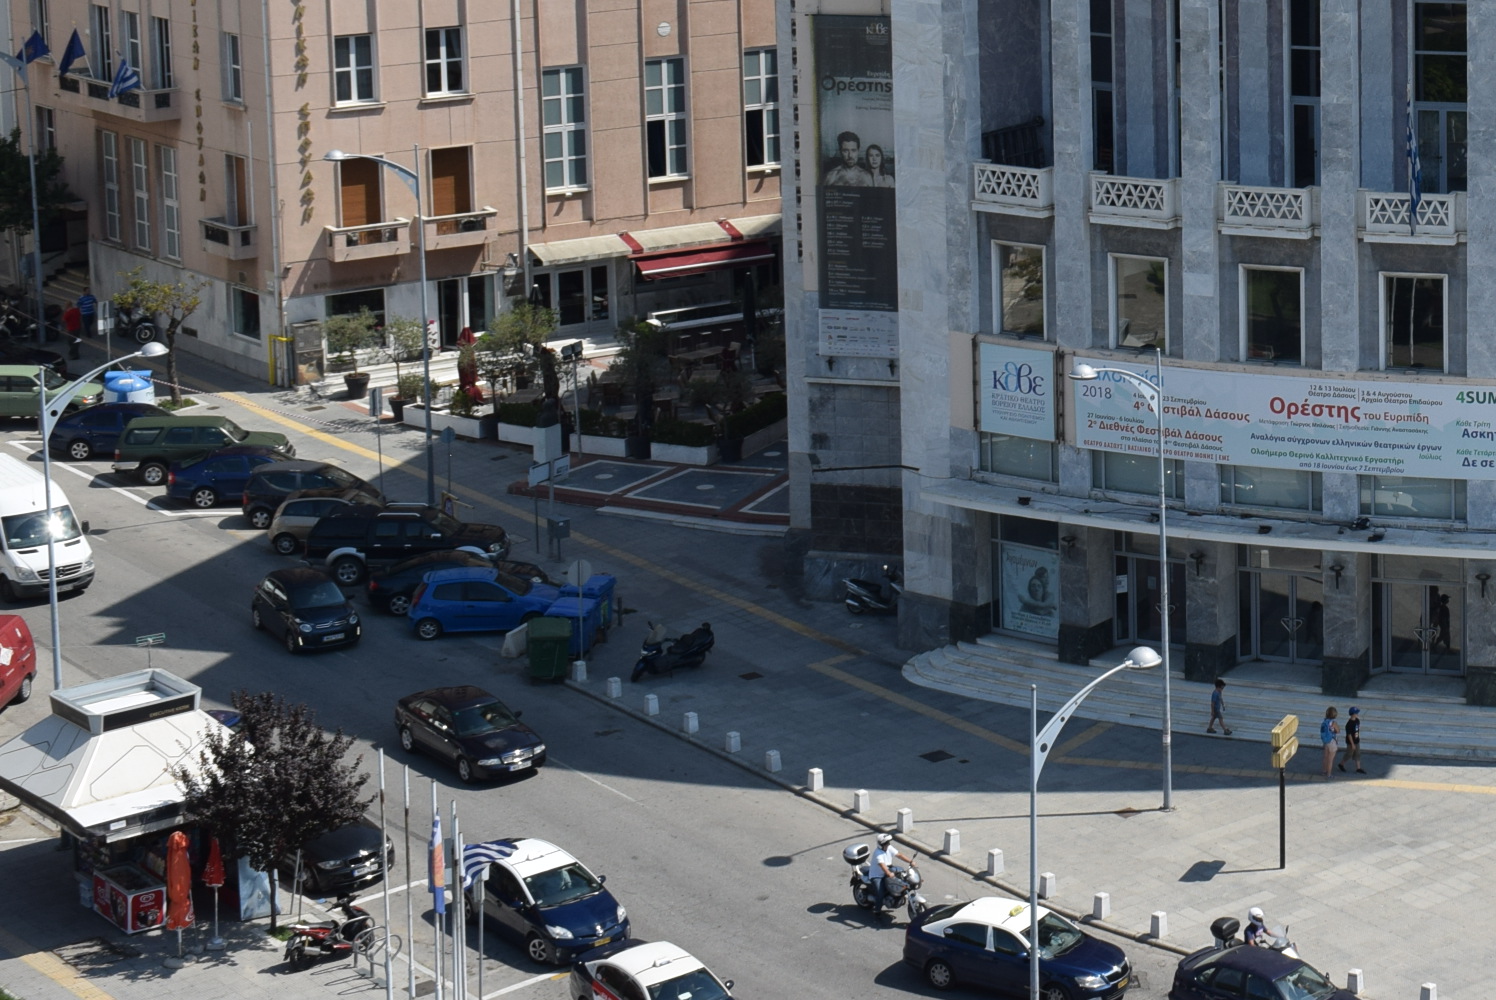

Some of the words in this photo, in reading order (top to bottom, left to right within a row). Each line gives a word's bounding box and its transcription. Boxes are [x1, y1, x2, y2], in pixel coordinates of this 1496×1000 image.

[821, 75, 892, 95] Ορέστης
[1082, 385, 1112, 399] 2018
[1308, 390, 1331, 399] Θέατρο
[1332, 391, 1357, 400] Δάσους
[1377, 391, 1412, 400] Αυγούστου
[992, 393, 1018, 401] ΚΡΑΤΙΚΟ
[1021, 397, 1045, 406] ΘΕΑΤΡΟ
[1171, 396, 1207, 405] Σεπτεμβρίου
[1361, 397, 1383, 405] Αρχαίο
[1384, 397, 1407, 406] Θέατρο
[1409, 398, 1443, 406] Επιδαύρου
[992, 400, 1017, 409] ΒΟΡΕΙΟΥ
[1018, 403, 1045, 413] ΕΛΛΑΔΟΣ
[1148, 404, 1202, 417] στιβάλ
[1205, 408, 1250, 422] Δάσους
[1269, 396, 1361, 423] Ορέστης
[1363, 412, 1381, 421] του
[1384, 412, 1429, 424] Ευριπίδη
[1095, 413, 1116, 421] Ιουνίου
[1290, 421, 1311, 429] Γιώργος
[1473, 421, 1491, 429] Τρίτη
[1099, 421, 1134, 434] Διεθνές
[1185, 429, 1223, 443] Δάσους
[1104, 442, 1123, 450] ΔΑΣΟΥΣ
[1128, 445, 1151, 453] ΒΑΣΙΛΙΚΟ
[1132, 436, 1152, 444] πλαίσιο
[1173, 441, 1200, 450] Φεστιβάλ
[1201, 444, 1223, 452] Δάσους
[1251, 433, 1286, 443] Αναλόγια
[1287, 435, 1330, 447] σύγχρονων
[1332, 438, 1373, 448] ελληνικών
[1374, 440, 1415, 451] θεατρικών
[1417, 444, 1442, 452] έργων
[1251, 448, 1287, 458] Ολοήμερο
[1289, 451, 1314, 460] Θερινό
[1316, 452, 1363, 463] Καλλιτεχνικό
[1365, 456, 1404, 465] Εργαστήρι
[1419, 453, 1442, 461] Ιούλιος
[1462, 457, 1478, 468] Δε
[1480, 459, 1494, 468] σε
[1299, 461, 1312, 469] από
[1346, 464, 1358, 472] έως
[1364, 465, 1405, 474] Σεπτεμβρίου
